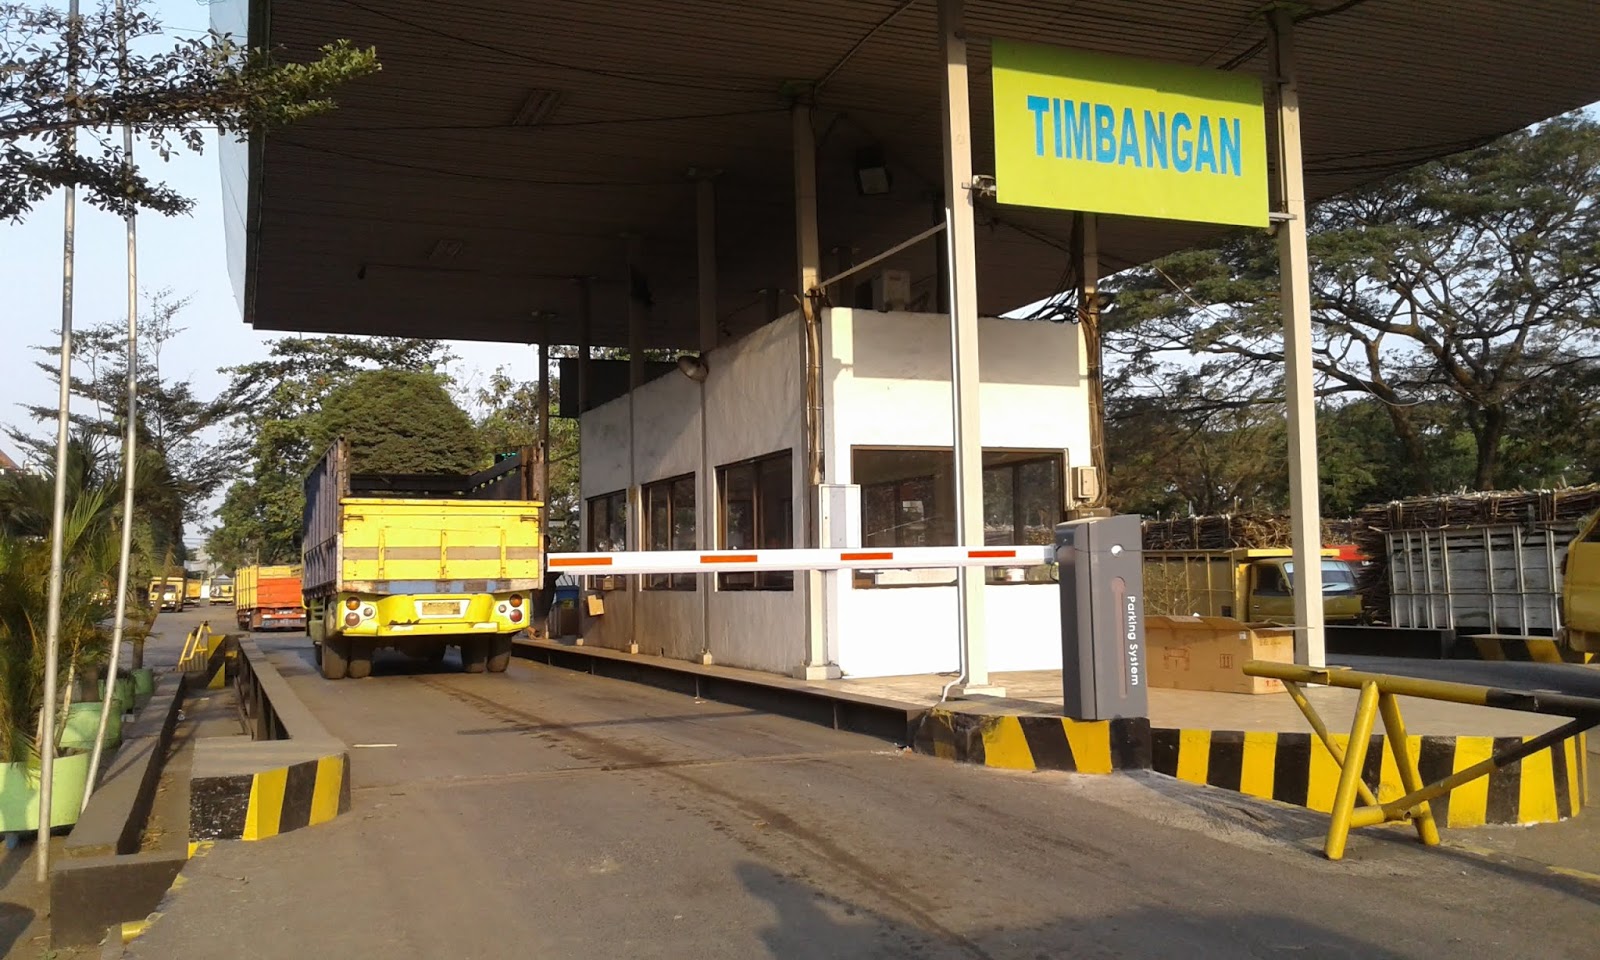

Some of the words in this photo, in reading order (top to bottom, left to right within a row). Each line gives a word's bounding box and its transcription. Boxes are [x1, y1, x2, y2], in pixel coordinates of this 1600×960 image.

[1027, 95, 1242, 177] TIMBANGAN
[1127, 595, 1138, 641] Parking
[1128, 643, 1139, 686] System
